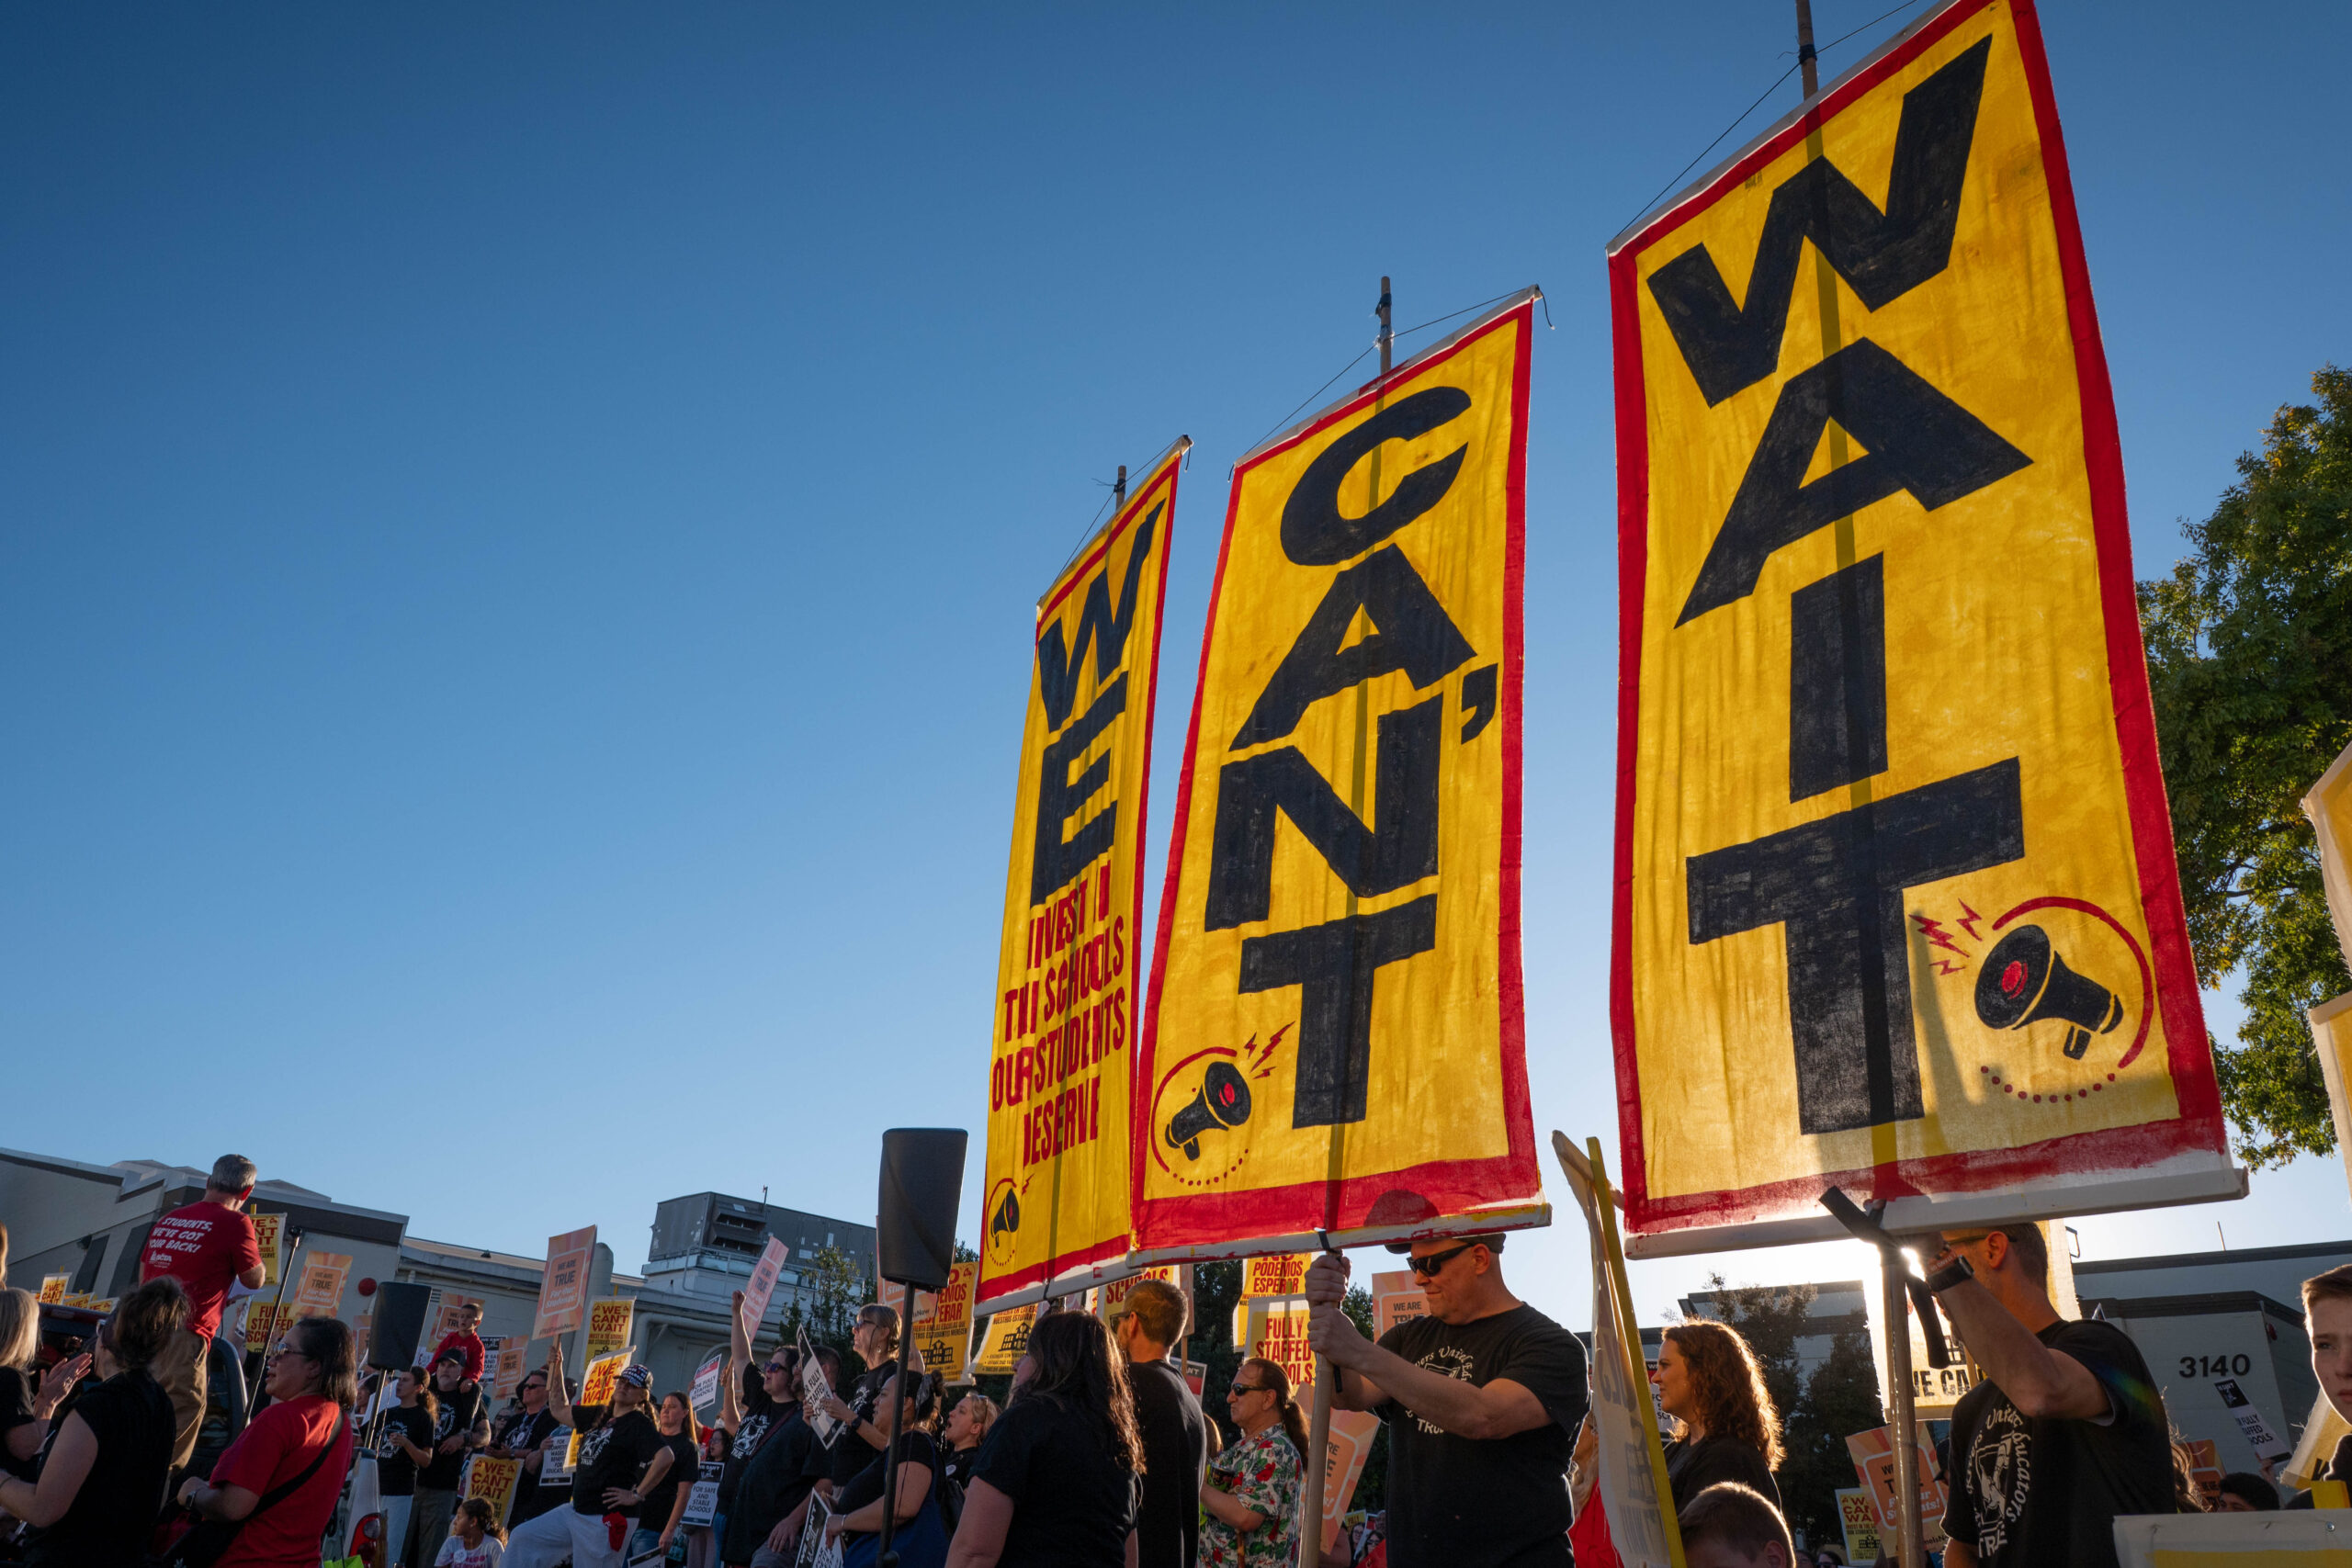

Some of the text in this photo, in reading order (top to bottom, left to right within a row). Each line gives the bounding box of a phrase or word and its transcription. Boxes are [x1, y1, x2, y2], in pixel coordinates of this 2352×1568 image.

[1648, 34, 2033, 1135] WAIT
[1030, 497, 1167, 909] WE
[1205, 386, 1498, 1129] CAN'T
[1044, 915, 1125, 1022] SCHOOLS
[162, 1217, 213, 1232] STUDENTS,
[177, 1231, 205, 1241] GOT
[165, 1240, 202, 1254] BACK!
[1252, 1261, 1304, 1277] PODEMOS
[311, 1279, 333, 1290] TRUE
[554, 1269, 577, 1287] TRUE
[1253, 1277, 1299, 1294] ESPERAR
[937, 1283, 967, 1303] EMOS
[602, 1305, 621, 1314] WE
[1393, 1301, 1421, 1312] WE ARE
[250, 1317, 294, 1331] STAFED
[592, 1323, 625, 1332] WAIT
[1265, 1316, 1305, 1339] FULLY
[1255, 1340, 1312, 1361] STAFFED
[597, 1362, 616, 1377] WE
[2178, 1353, 2251, 1378] 3140
[485, 1461, 506, 1475] WE
[471, 1483, 506, 1500] WAIT
[705, 1486, 717, 1495] SAFE
[688, 1506, 712, 1514] SCHOOLS
[692, 1499, 710, 1507] STABLE
